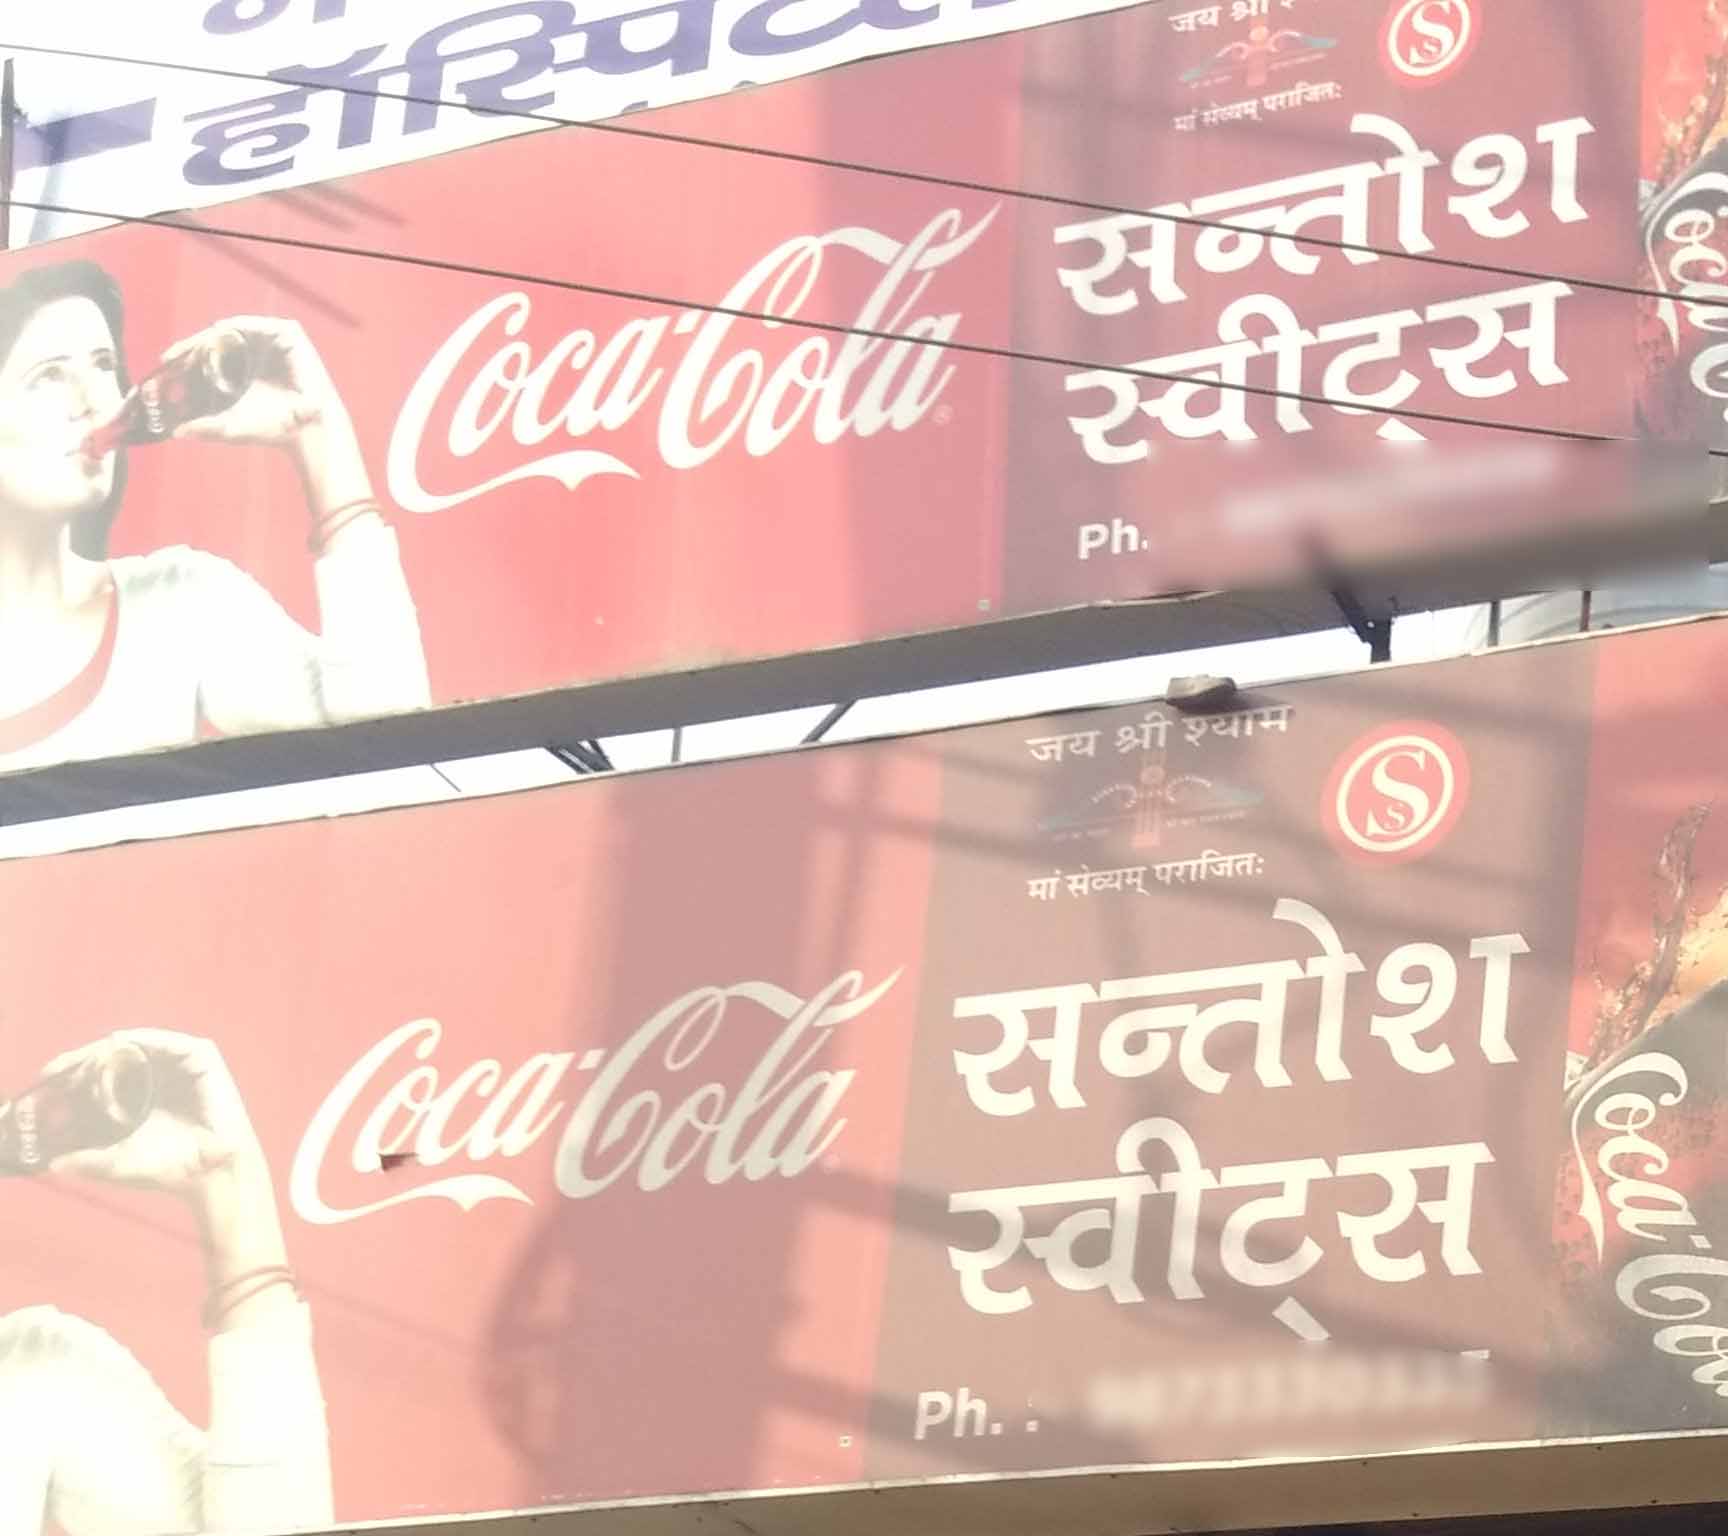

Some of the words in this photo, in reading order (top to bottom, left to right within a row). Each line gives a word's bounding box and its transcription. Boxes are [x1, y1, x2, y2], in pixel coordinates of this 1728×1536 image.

[388, 198, 1000, 513] Coca-Cola
[1078, 521, 1149, 560] Ph.
[1026, 730, 1102, 762] जय
[1114, 712, 1173, 753] श्री
[1154, 848, 1265, 886] पराजितः
[288, 966, 906, 1225] Coca-Cola
[951, 897, 1532, 1117] सन्तोश
[946, 1116, 1497, 1344] स्वीट्स
